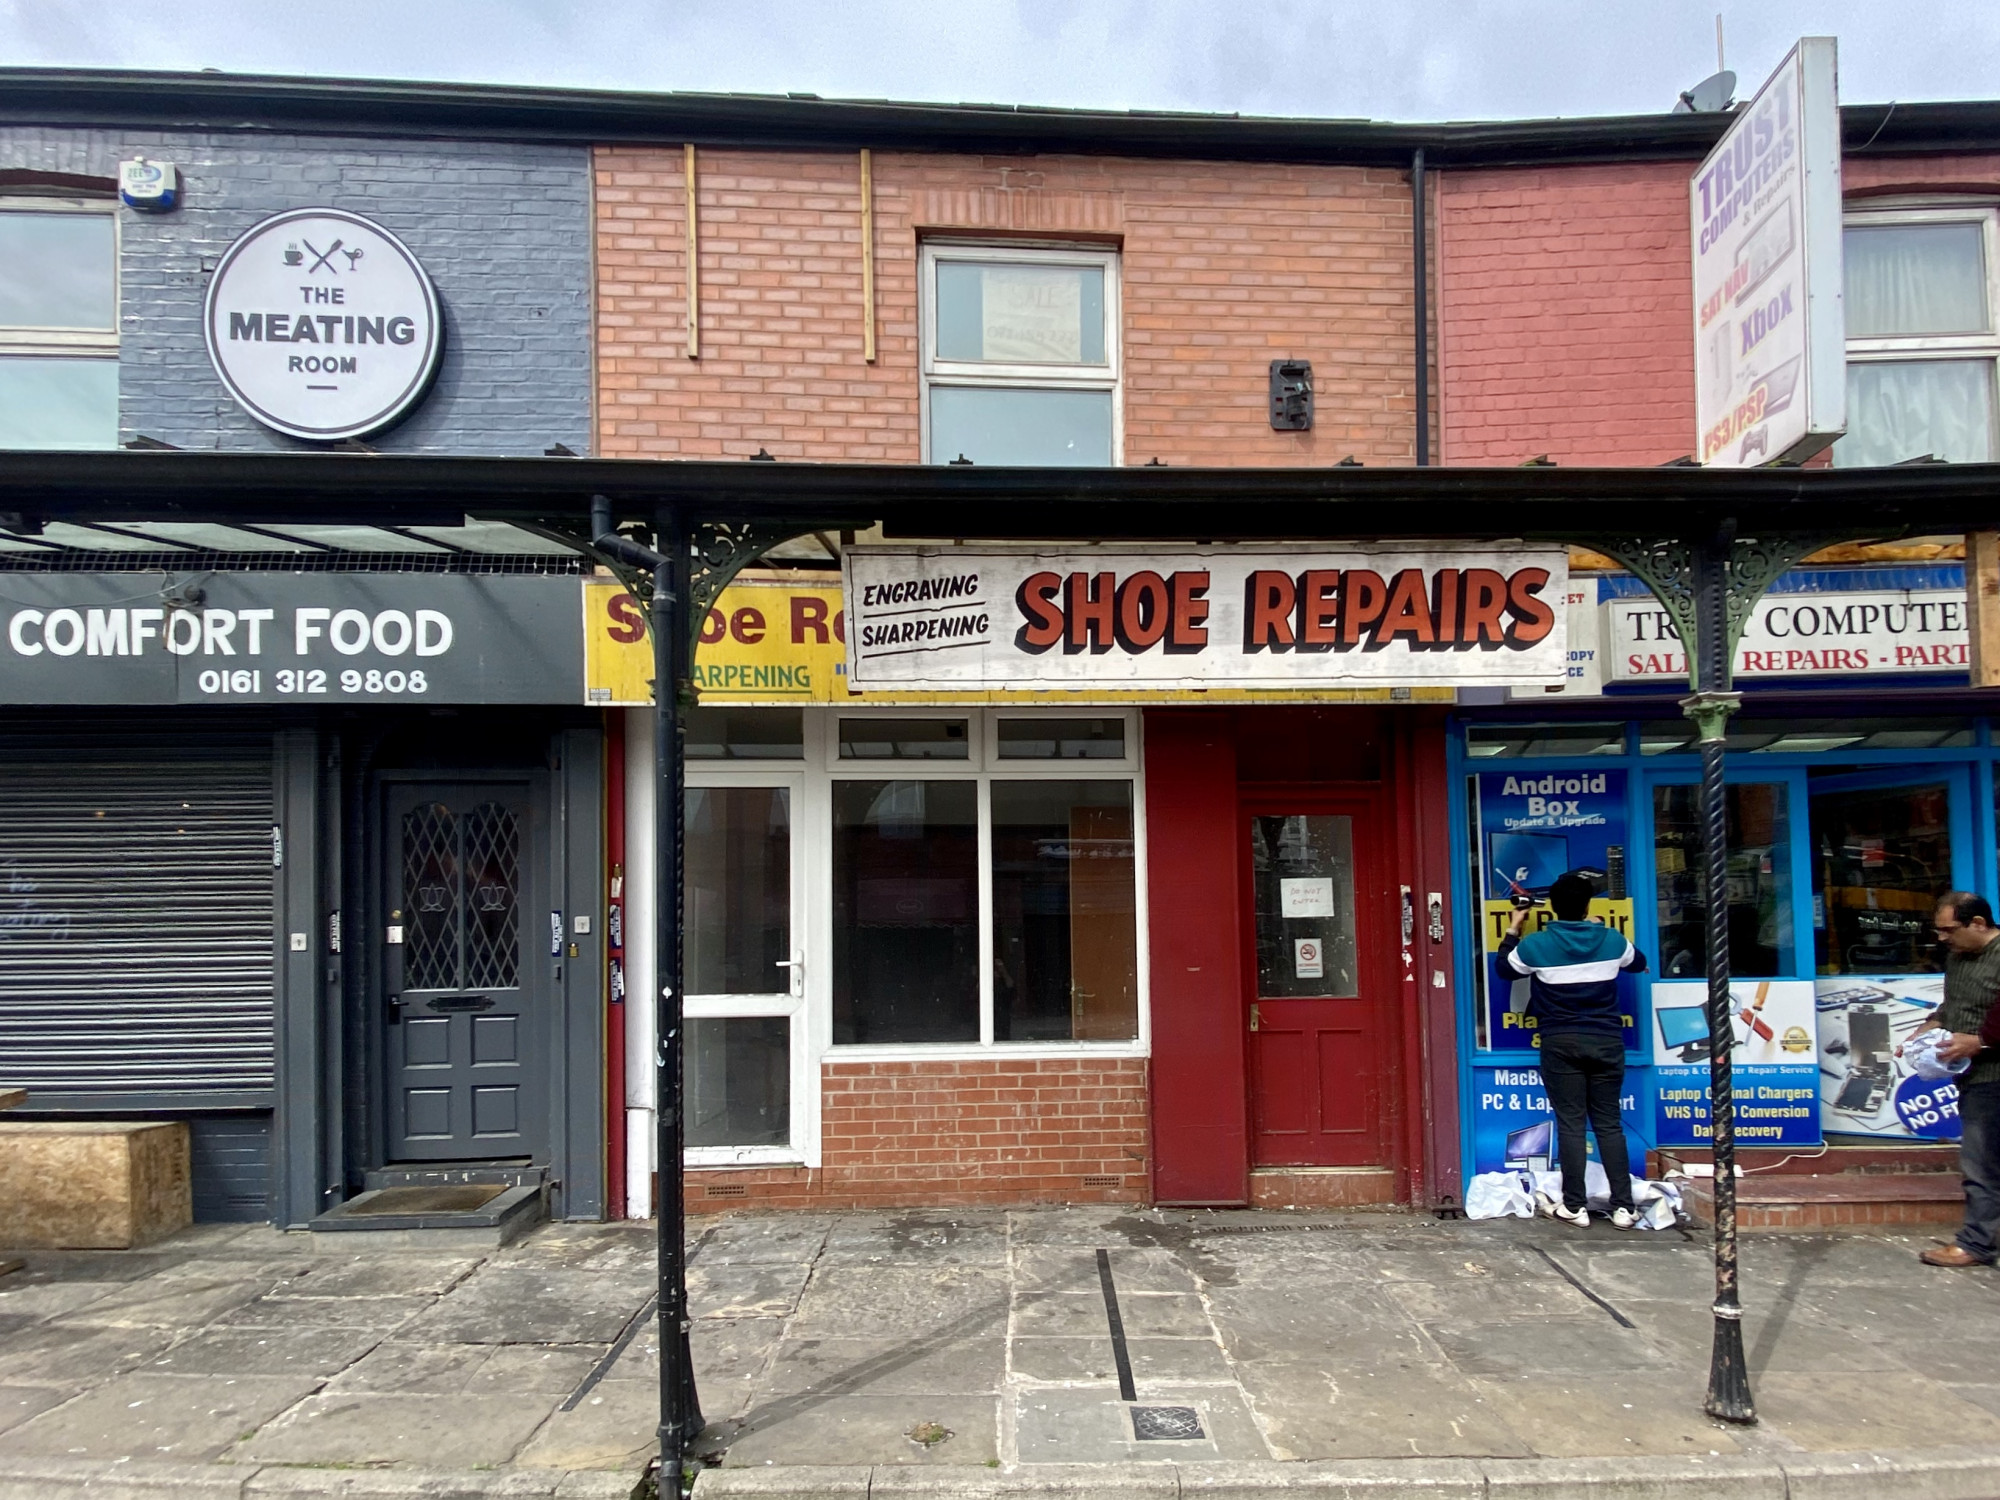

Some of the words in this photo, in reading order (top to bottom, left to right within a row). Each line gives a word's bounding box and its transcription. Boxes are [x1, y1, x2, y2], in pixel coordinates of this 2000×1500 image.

[1699, 76, 1791, 223] TRUST
[1700, 128, 1794, 256] COMPUTERS
[1754, 161, 1796, 216] Repairs
[300, 286, 345, 304] THE
[1701, 286, 1722, 329] SAT
[1725, 257, 1749, 306] NAV
[230, 312, 416, 345] MEATING
[1741, 283, 1793, 357] Xbox
[288, 355, 357, 374] ROOM
[1704, 386, 1766, 461] PS3/PSP
[863, 574, 979, 607] ENGRAVING
[1567, 593, 1585, 605] ET
[607, 593, 766, 644] Soe
[1014, 570, 1210, 655] SHOE
[1242, 567, 1555, 655] REPAIRS
[1765, 601, 1969, 637] COMPUTE
[9, 608, 273, 656] COMFORT
[295, 608, 453, 657] FOOD
[862, 613, 990, 647] SHARPENING
[1743, 649, 1869, 671] REPAIRS
[1896, 644, 1970, 667] PART
[199, 669, 261, 694] 0161
[276, 669, 327, 694] 312
[340, 669, 428, 694] 9808
[693, 665, 811, 687] ARPENING
[1502, 774, 1606, 795] Android
[1528, 797, 1579, 816] Box
[1504, 817, 1544, 828] Update
[1547, 817, 1556, 826] &
[1559, 816, 1606, 827] Upgrade
[1495, 1069, 1545, 1086] MacB
[1658, 1067, 1689, 1076] Laptop
[1748, 1066, 1777, 1076] Repair
[1780, 1065, 1814, 1075] Service
[1482, 1093, 1504, 1110] PC
[1509, 1093, 1521, 1110] &
[1660, 1088, 1701, 1102] Laptop
[1758, 1086, 1814, 1102] Chargers
[1899, 1094, 1932, 1115] NO
[1664, 1106, 1691, 1119] VHS
[1694, 1106, 1707, 1118] to
[1740, 1105, 1810, 1119] Conversion
[1908, 1110, 1939, 1130] NO
[1734, 1125, 1783, 1139] ecovery
